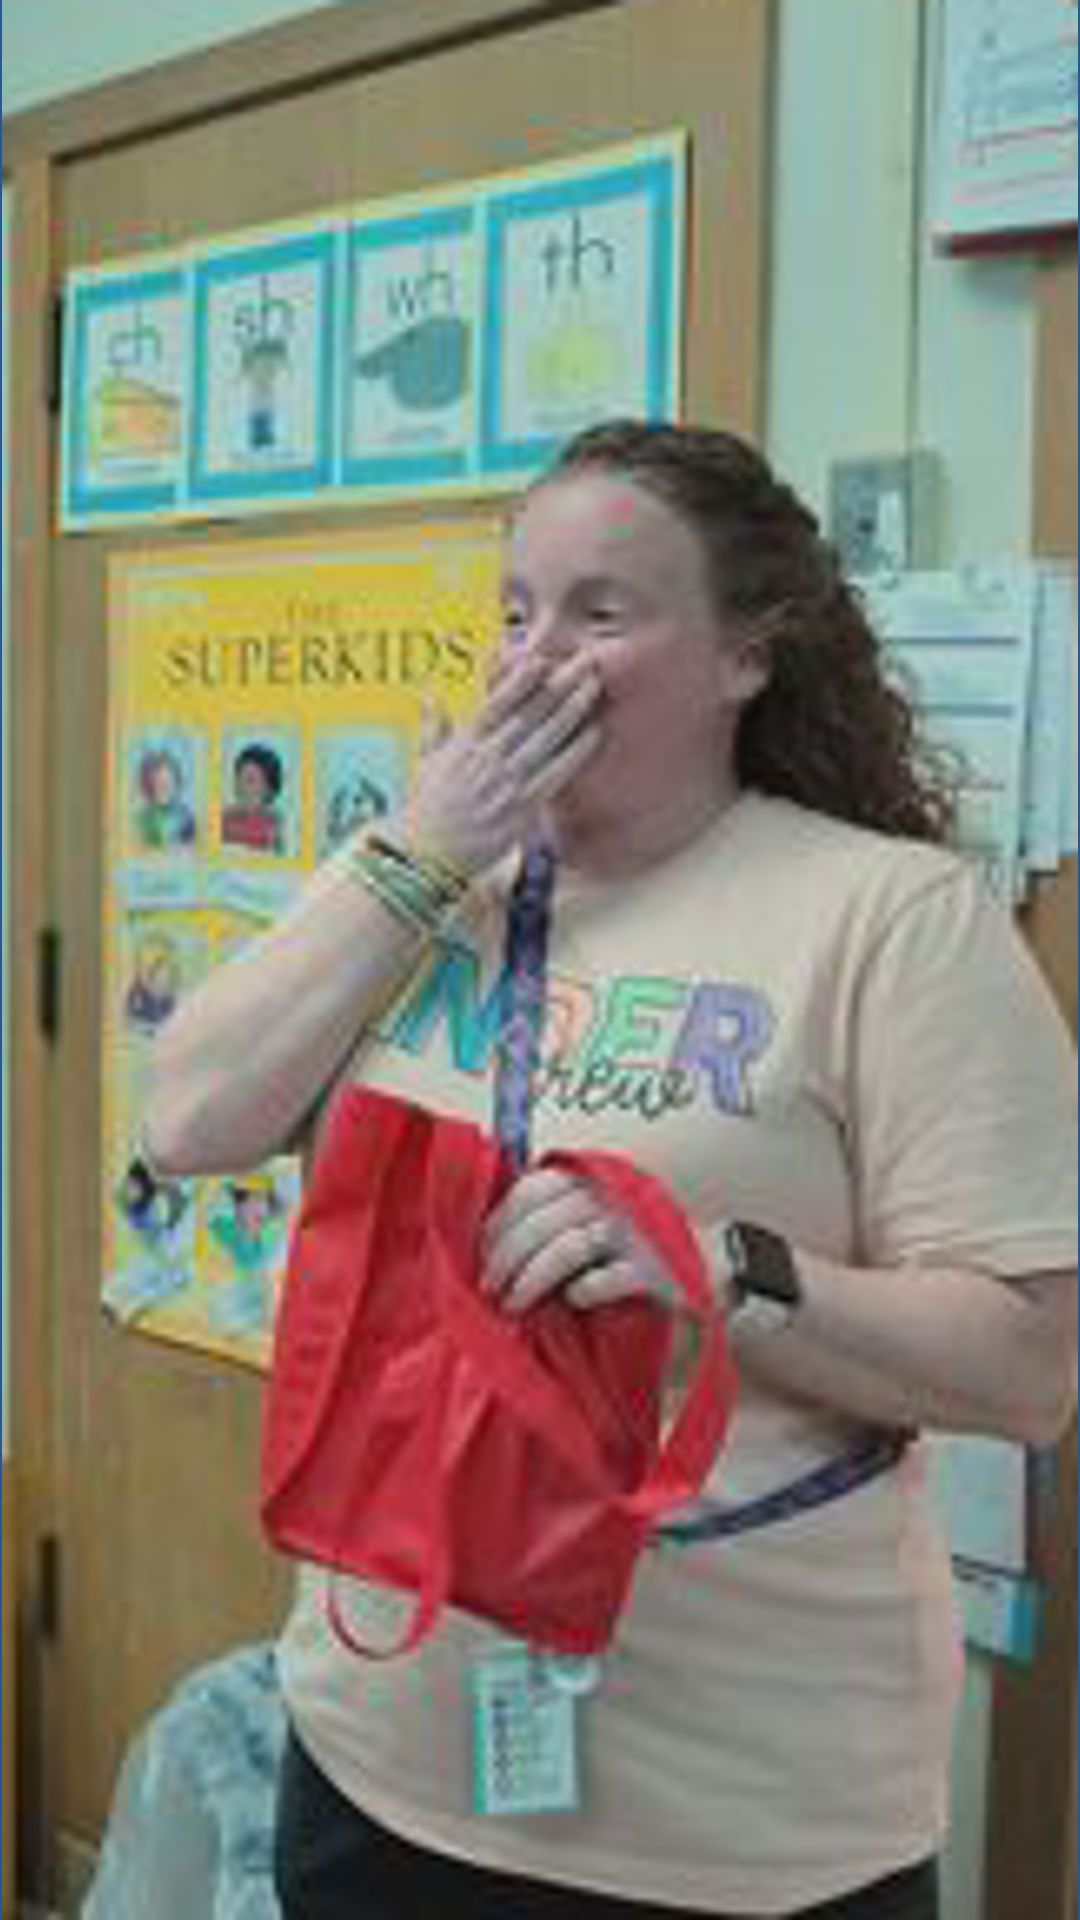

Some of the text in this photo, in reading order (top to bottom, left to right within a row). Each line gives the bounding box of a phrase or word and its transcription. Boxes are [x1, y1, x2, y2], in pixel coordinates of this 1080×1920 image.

[386, 242, 455, 319] wh
[540, 213, 615, 291] th
[107, 301, 163, 367] ch
[234, 275, 294, 348] sh
[162, 630, 477, 688] SUPERKIDS
[530, 1056, 697, 1122] rew
